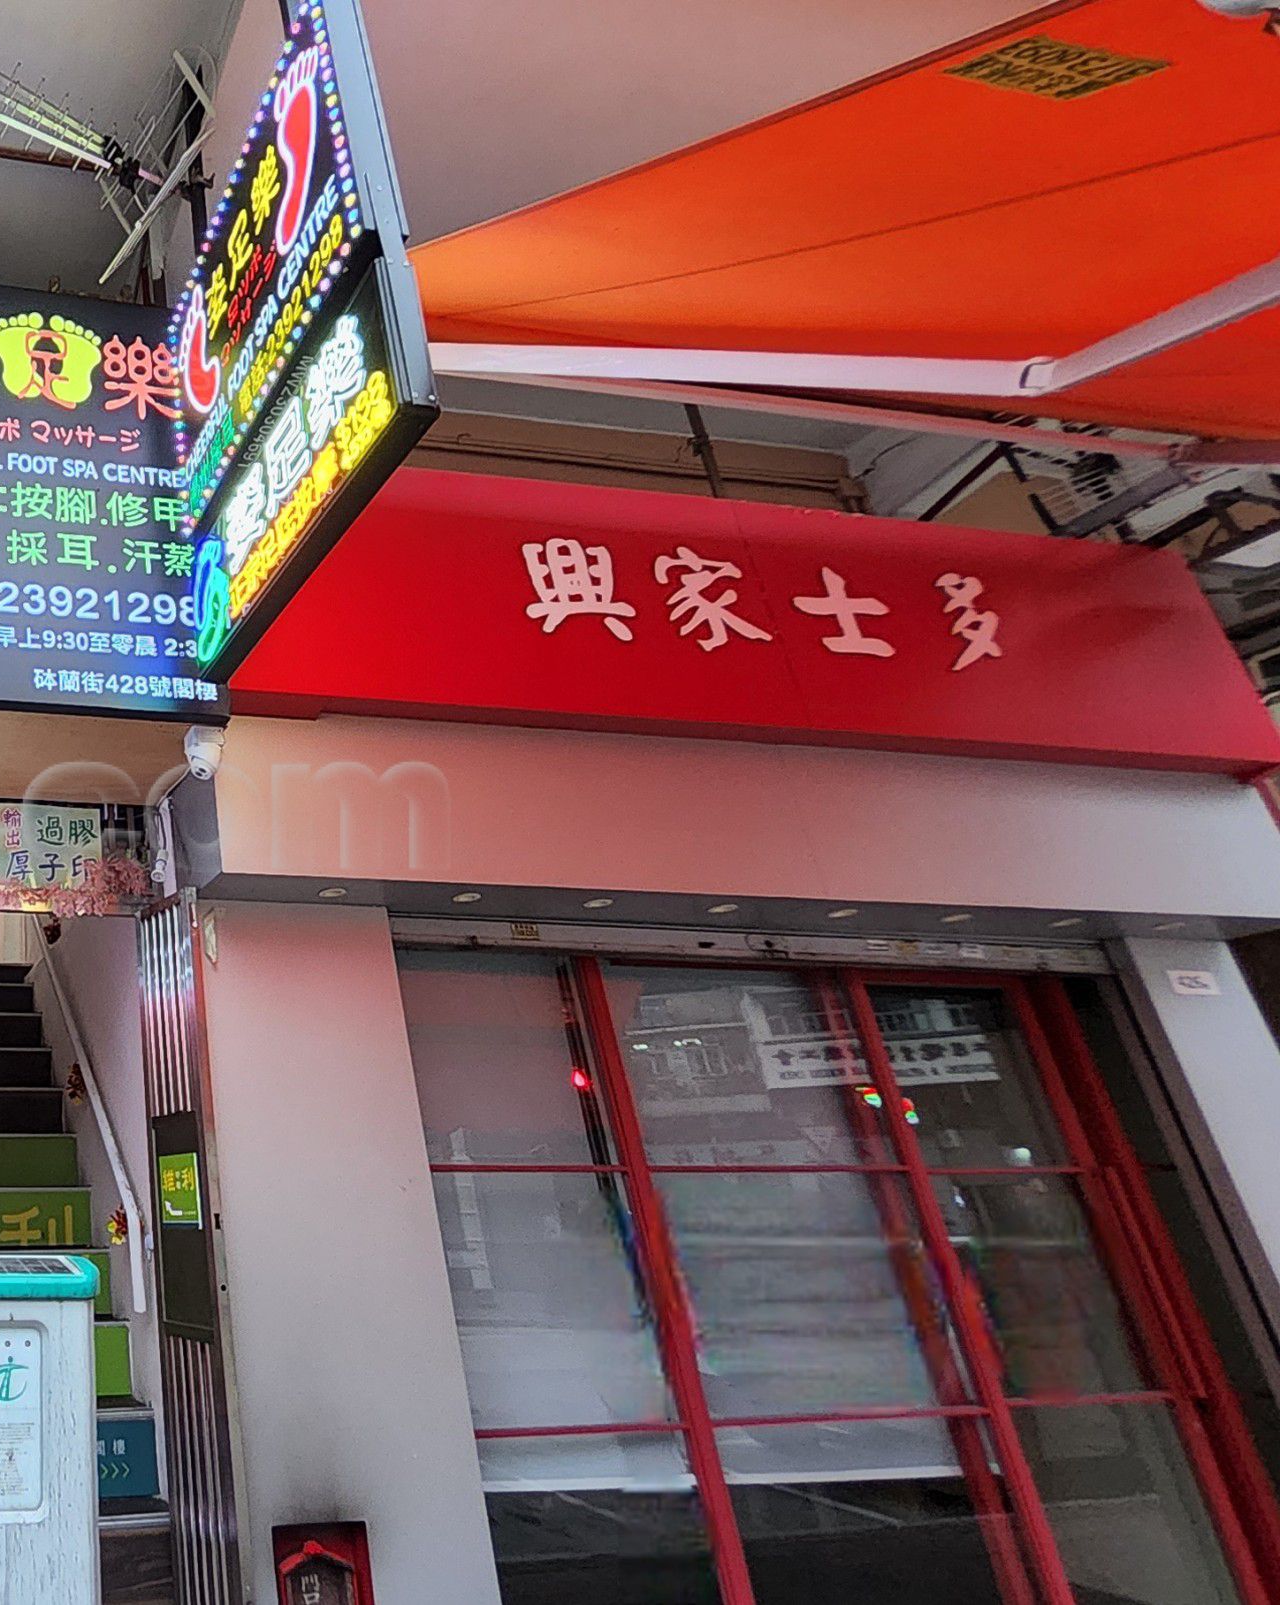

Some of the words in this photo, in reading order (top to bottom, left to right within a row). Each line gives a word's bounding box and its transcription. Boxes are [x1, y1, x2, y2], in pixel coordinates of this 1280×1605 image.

[228, 333, 256, 400] FOOT
[254, 294, 280, 348] SPA
[277, 174, 341, 300] CENTRE
[7, 452, 59, 476] FOOT
[62, 458, 99, 481] SPA
[103, 462, 188, 489] CENTRE
[521, 538, 1005, 672] 興家士多
[32, 668, 219, 701] 砵蘭街428號閣樓
[36, 815, 98, 847] 過膠
